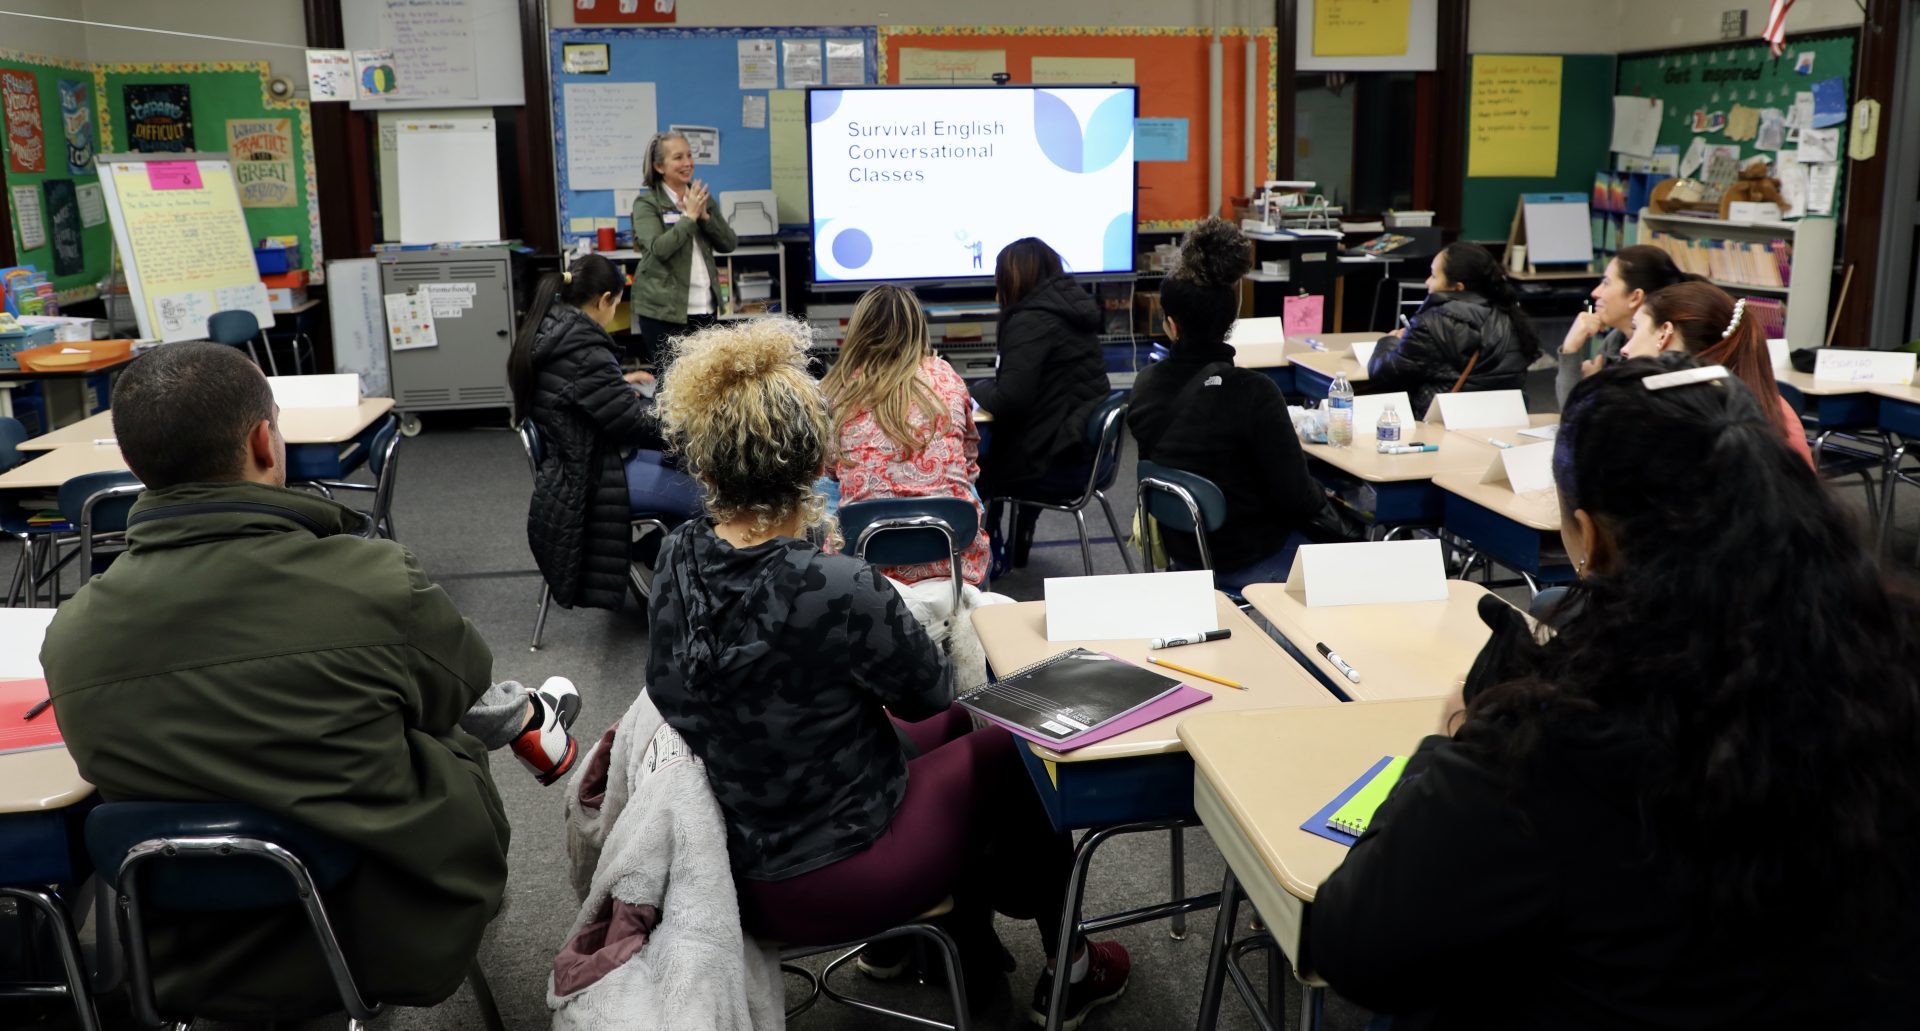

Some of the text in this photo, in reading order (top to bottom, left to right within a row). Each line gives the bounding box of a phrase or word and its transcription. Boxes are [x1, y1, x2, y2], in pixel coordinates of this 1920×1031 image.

[1664, 66, 1692, 84] Get
[1701, 60, 1764, 88] inspired
[135, 123, 185, 141] DIFFICULT
[232, 123, 266, 140] WHEN
[848, 120, 1004, 139] Survival English
[232, 132, 288, 157] PRACTICE
[848, 143, 993, 160] Conversational
[236, 162, 289, 184] GREAT
[849, 167, 925, 183] Classes
